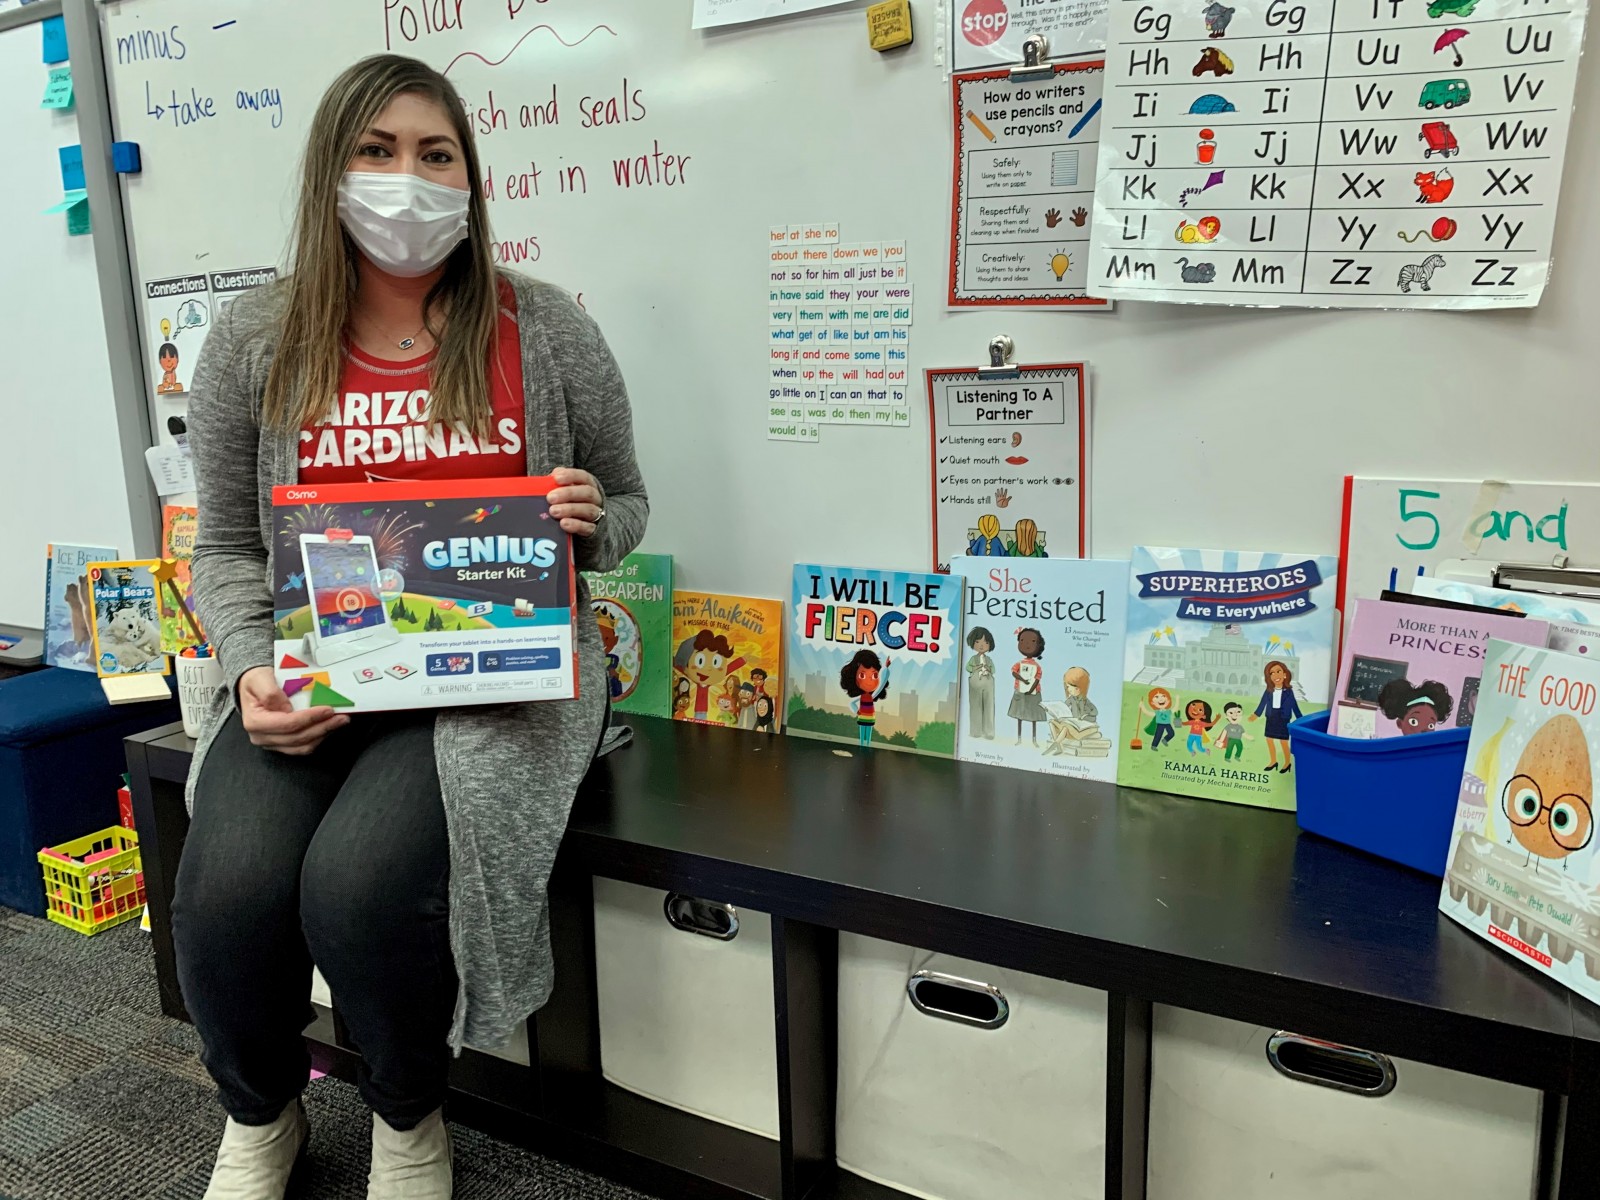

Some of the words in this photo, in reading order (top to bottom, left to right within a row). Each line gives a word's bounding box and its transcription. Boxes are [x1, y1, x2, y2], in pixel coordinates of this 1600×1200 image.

[384, 0, 463, 51] Polar
[964, 12, 1007, 31] stop
[1134, 6, 1172, 40] Gg
[1266, 0, 1306, 33] Gg
[117, 26, 186, 64] minus
[1357, 38, 1399, 65] Uu
[1506, 25, 1552, 54] Uu
[1129, 48, 1168, 76] Hh
[1259, 42, 1302, 71] Hh
[984, 92, 1011, 104] How
[1016, 89, 1031, 101] do
[1036, 85, 1085, 99] writers
[1356, 83, 1393, 111] Vv
[1504, 73, 1544, 102] Vv
[169, 88, 216, 127] take
[236, 87, 283, 128] away
[520, 83, 559, 129] and
[579, 78, 646, 128] seals
[986, 110, 1006, 120] use
[1011, 103, 1054, 121] pencils
[1059, 101, 1083, 114] and
[1133, 93, 1158, 117] Ii
[1263, 88, 1290, 114] Ii
[1004, 120, 1063, 138] crayons?
[1340, 128, 1397, 155] Ww
[1486, 120, 1547, 150] Ww
[1127, 134, 1156, 167] Jj
[1255, 131, 1287, 165] Jj
[507, 162, 542, 200] eat
[559, 156, 586, 194] in
[613, 139, 690, 188] water
[981, 171, 996, 179] Using
[993, 158, 1020, 168] Safely:
[1123, 174, 1156, 201] Kk
[1251, 173, 1286, 200] Kk
[1339, 172, 1384, 199] Xx
[1483, 168, 1532, 196] Xx
[980, 205, 1030, 216] Respectfully:
[771, 232, 785, 240] her
[790, 231, 799, 240] at
[805, 229, 821, 239] she
[826, 229, 837, 238] no
[1122, 215, 1147, 240] Ll
[1250, 215, 1275, 242] Ll
[1338, 216, 1376, 250] Yy
[1482, 214, 1523, 249] Yy
[772, 250, 798, 260] about
[803, 250, 827, 259] there
[833, 248, 858, 258] down
[863, 248, 877, 256] we
[884, 246, 903, 258] you
[982, 254, 1025, 262] Creatively:
[215, 272, 275, 289] Questioning
[1106, 255, 1156, 280] Mm
[1232, 258, 1284, 284] Mm
[1330, 259, 1372, 285] Zz
[1472, 259, 1518, 286] Zz
[148, 279, 206, 296] Connections
[770, 291, 777, 300] in
[781, 290, 801, 299] have
[805, 290, 824, 299] said
[830, 290, 850, 301] they
[857, 289, 879, 298] your
[886, 289, 910, 297] were
[771, 349, 789, 361] long
[793, 350, 799, 358] if
[803, 349, 820, 358] and
[825, 351, 850, 360] come
[855, 351, 880, 359] some
[888, 349, 905, 358] this
[315, 389, 493, 426] ARIZO
[956, 390, 1018, 404] Listening
[1023, 389, 1037, 401] To
[1043, 388, 1053, 400] A
[977, 408, 1033, 421] Partner
[299, 418, 521, 468] CARDINALS
[769, 426, 796, 435] would
[801, 428, 806, 436] a
[811, 427, 817, 436] is
[949, 435, 984, 446] Listening
[950, 456, 970, 465] Quiet
[974, 456, 1000, 465] mouth
[949, 475, 968, 486] Eyes
[984, 477, 1023, 488] partner's
[1027, 476, 1048, 484] work
[287, 490, 317, 500] Osmo
[950, 496, 974, 504] Hands
[977, 496, 991, 504] still
[1396, 489, 1440, 550] 5
[1469, 498, 1568, 551] and
[175, 535, 191, 547] BIG
[423, 535, 557, 570] GENIUS
[58, 549, 73, 564] ICE
[627, 564, 638, 575] of
[457, 568, 504, 582] Starter
[507, 568, 526, 579] Kit
[989, 568, 1032, 593] She
[1150, 568, 1306, 594] SUPERHEROES
[96, 590, 119, 598] Polar
[124, 589, 152, 597] Bears
[810, 575, 820, 599] I
[831, 577, 893, 606] WILL
[906, 583, 940, 610] BE
[967, 587, 1106, 624] Persisted
[474, 605, 486, 614] B
[701, 598, 765, 634] Alaikum
[1185, 603, 1211, 617] Are
[1217, 597, 1305, 619] Everywhere
[805, 603, 942, 653] FIERCE!
[1397, 618, 1436, 634] MORE
[1441, 626, 1478, 640] THAN
[184, 666, 204, 684] BEST
[1498, 664, 1530, 698] THE
[1540, 675, 1596, 715] GOOD
[1052, 762, 1081, 772] Illustrated
[1165, 761, 1216, 776] KAMALA
[1221, 769, 1269, 783] HARRIS
[1161, 772, 1195, 782] Illustrated
[1197, 777, 1205, 785] by
[1207, 779, 1232, 787] Mechal
[1234, 783, 1255, 791] Renee
[1486, 874, 1500, 890] Jory
[1502, 880, 1519, 899] John
[1527, 896, 1543, 912] Pete
[1547, 906, 1572, 926] Oswald
[1496, 930, 1550, 964] SCHOLASTIC
